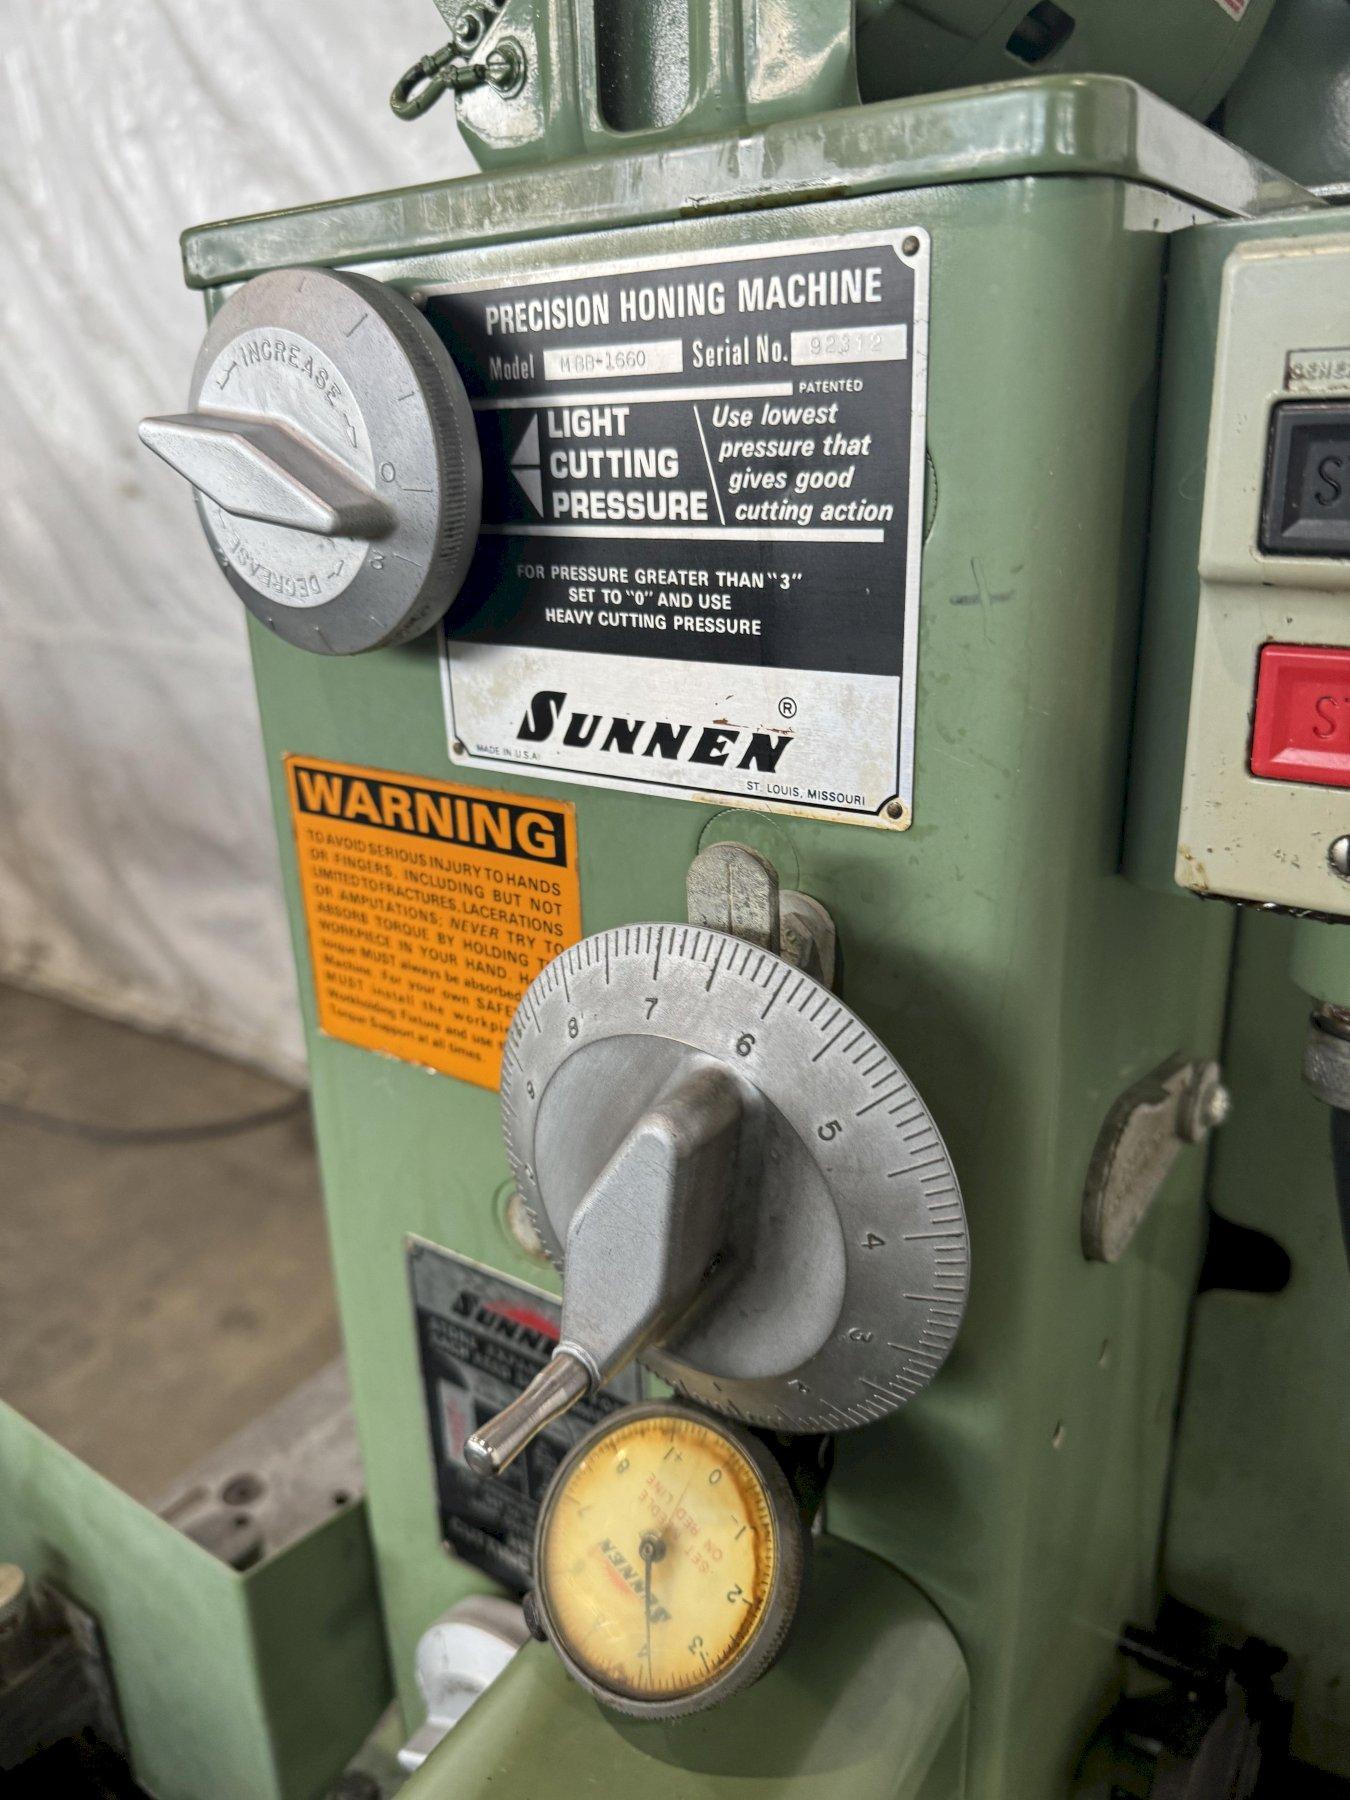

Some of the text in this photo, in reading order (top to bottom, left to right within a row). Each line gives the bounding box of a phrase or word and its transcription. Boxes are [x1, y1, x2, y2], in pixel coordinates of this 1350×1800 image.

[485, 267, 882, 336] PRECISION HONING MACHINE
[489, 353, 535, 381] Model
[692, 334, 750, 368] Serial
[756, 333, 789, 364] No.
[240, 340, 343, 407] INCREASE
[799, 377, 864, 394] PATENTED
[547, 405, 630, 438] LIGHT
[712, 401, 838, 428] Use lowest
[718, 432, 872, 463] pressure that
[550, 448, 679, 479] CUTTING
[728, 463, 855, 494] gives good
[552, 489, 708, 520] PRESSURE
[735, 498, 894, 526] cutting action
[228, 530, 323, 598] DECREASE
[517, 564, 545, 579] FOR
[551, 566, 629, 584] PRESSURE
[634, 568, 709, 587] GREATER
[716, 571, 764, 589] THAN
[569, 587, 594, 603] SET
[601, 588, 622, 605] TO
[657, 592, 693, 609] AND
[699, 593, 731, 610] USE
[545, 608, 762, 636] HEAVY CUTTING PRESSURE
[517, 689, 794, 774] SUNNEN
[476, 743, 500, 756] MADE
[503, 748, 512, 757] IN
[767, 783, 803, 799] LOUIS,
[807, 789, 865, 806] MISSOURI
[300, 770, 557, 859] WARNING
[307, 829, 561, 897] TO AVOID SERIOUS INJURY TO HANDS
[312, 866, 362, 890] LIMITED
[361, 877, 380, 894] TO
[462, 900, 564, 937] LACERATIONS
[403, 869, 485, 899] INCLUDING
[492, 889, 522, 908] BUT
[530, 897, 563, 917] NOT
[375, 916, 429, 942] TORQUE
[437, 932, 455, 948] BY
[463, 938, 529, 967] HOLDING
[449, 916, 499, 940] NEVER
[508, 930, 535, 949] TRY
[545, 939, 565, 956] TO
[361, 948, 397, 969] MUST
[445, 969, 459, 985] be
[399, 939, 413, 956] IN
[420, 945, 457, 967] YOUR
[645, 996, 659, 1020] 7
[567, 1016, 579, 1039] 8
[736, 1031, 757, 1058] 6
[817, 1119, 842, 1142] 5
[860, 1231, 885, 1250] 4
[708, 1467, 723, 1486] 0
